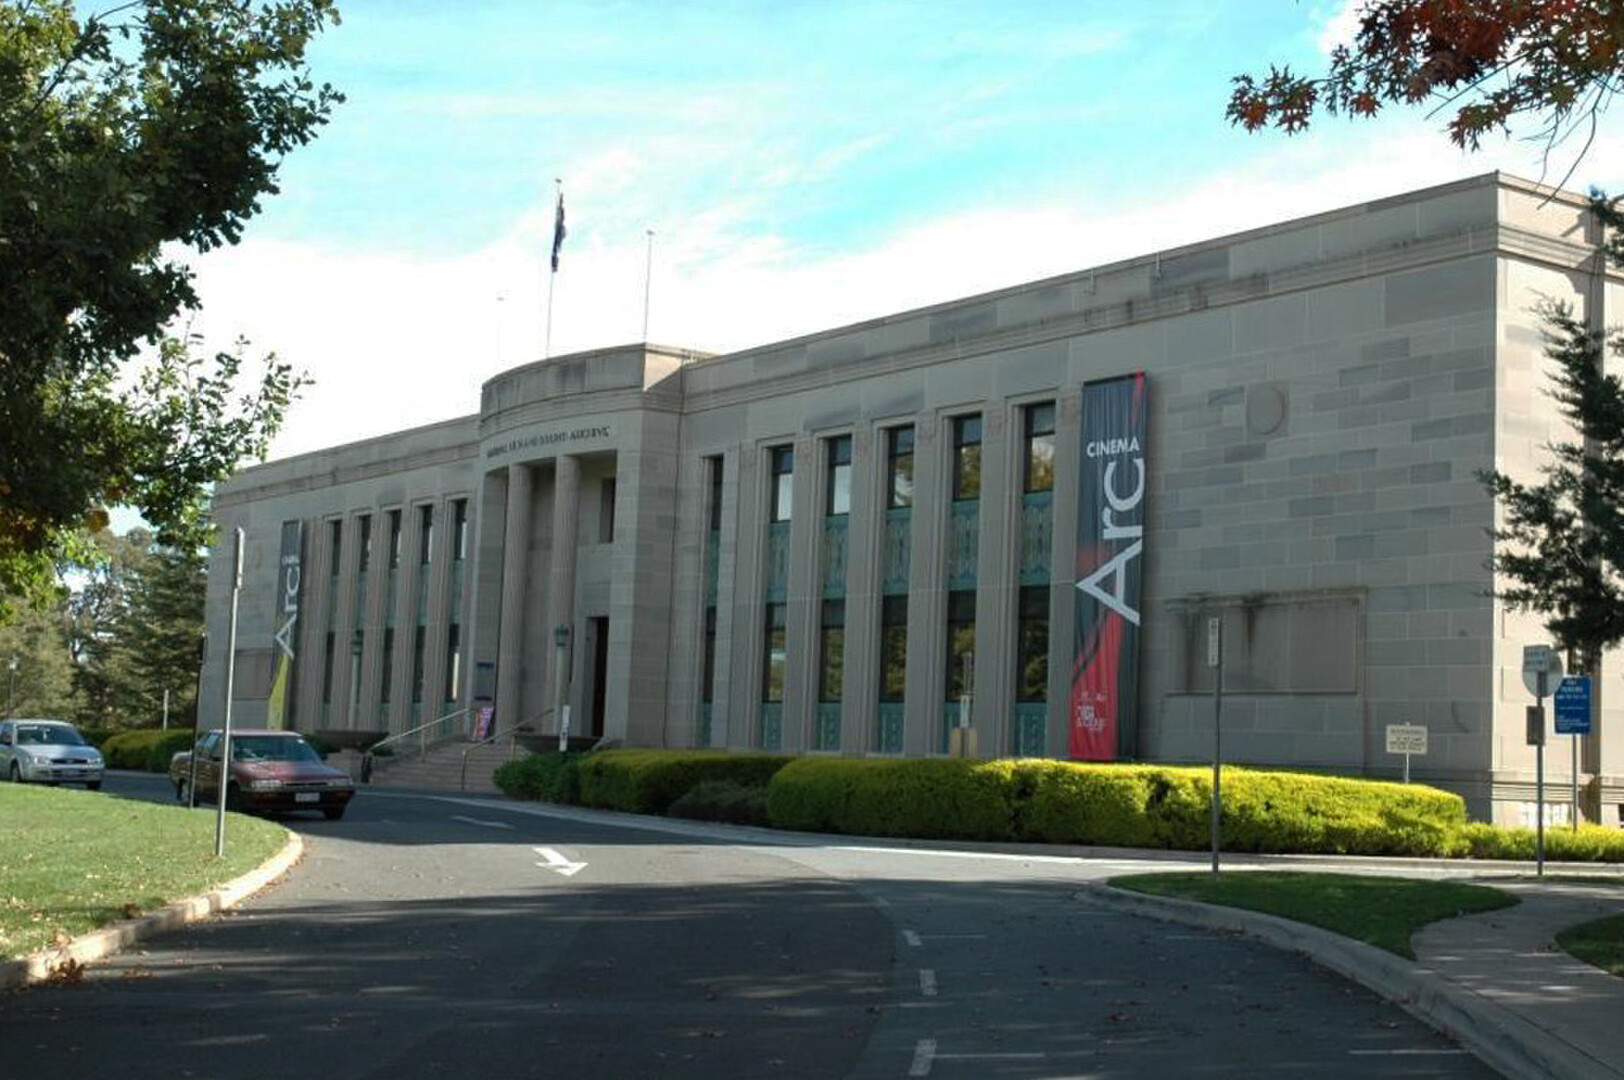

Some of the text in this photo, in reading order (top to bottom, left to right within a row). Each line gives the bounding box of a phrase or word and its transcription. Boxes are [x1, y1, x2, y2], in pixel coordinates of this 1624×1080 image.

[1087, 436, 1140, 458] CINEMA
[1075, 458, 1145, 627] Arc
[275, 565, 301, 661] Arc
